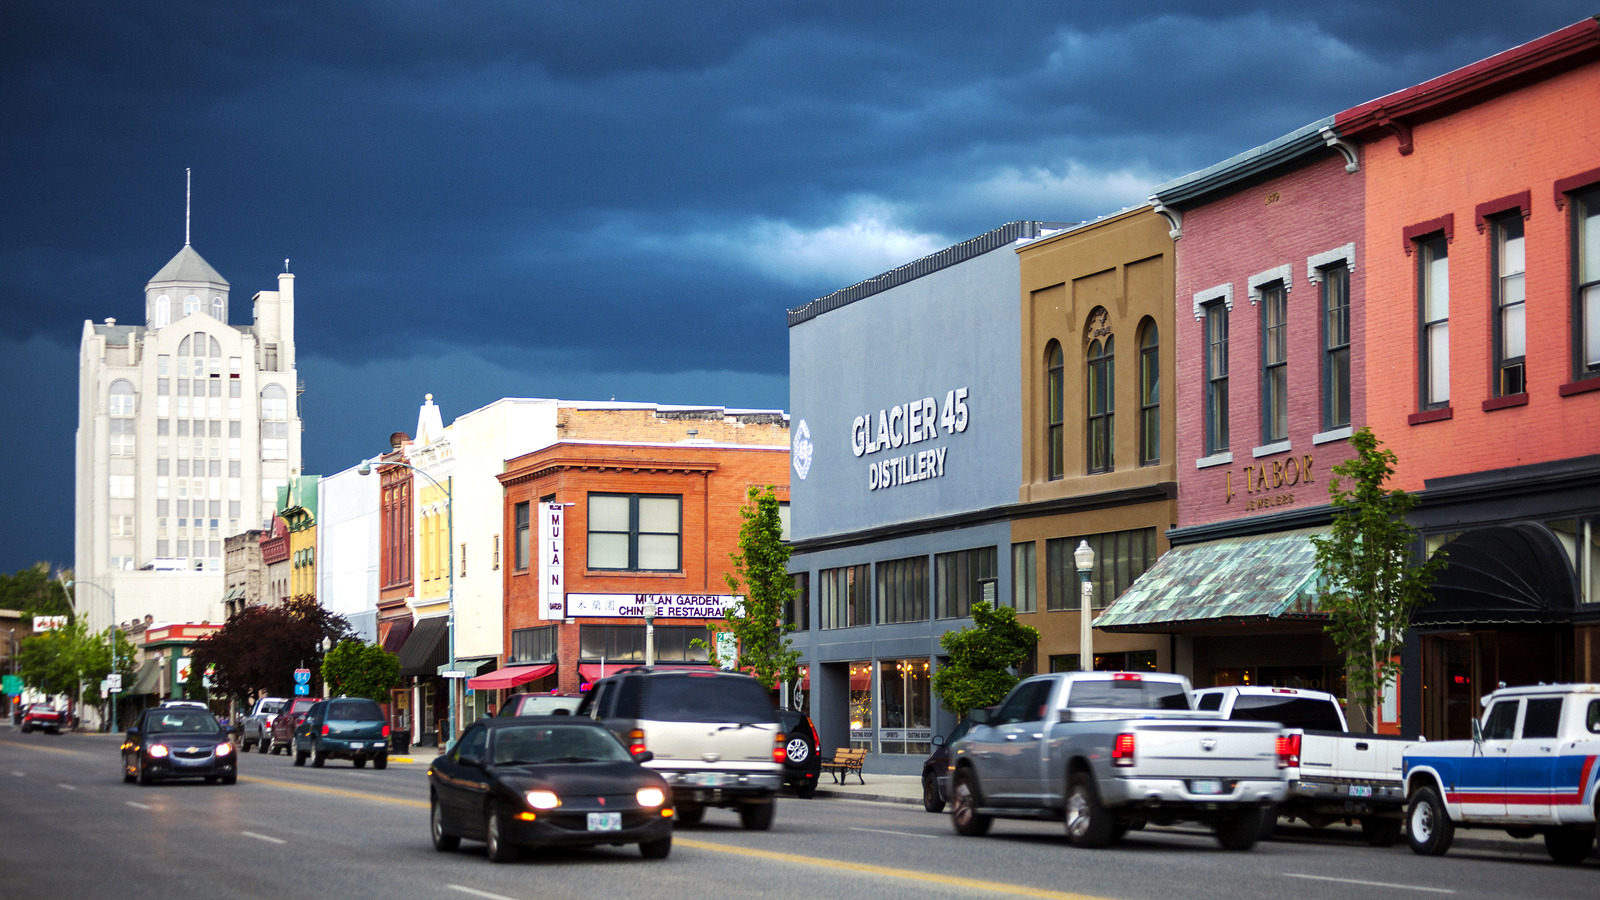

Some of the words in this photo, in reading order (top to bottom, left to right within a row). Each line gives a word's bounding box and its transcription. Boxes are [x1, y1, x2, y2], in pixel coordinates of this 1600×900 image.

[851, 396, 938, 457] GLACIER
[940, 386, 969, 434] 45
[868, 446, 947, 491] DISTILLERY
[1225, 470, 1236, 503] J.
[1243, 454, 1315, 493] TABOR
[1245, 493, 1295, 511] JEWELERS
[551, 513, 560, 586] MULAN
[676, 595, 720, 606] GARDEN
[619, 606, 664, 616] CHINE
[668, 607, 727, 616] RESTAURA
[717, 633, 723, 642] 2
[297, 673, 306, 682] 84
